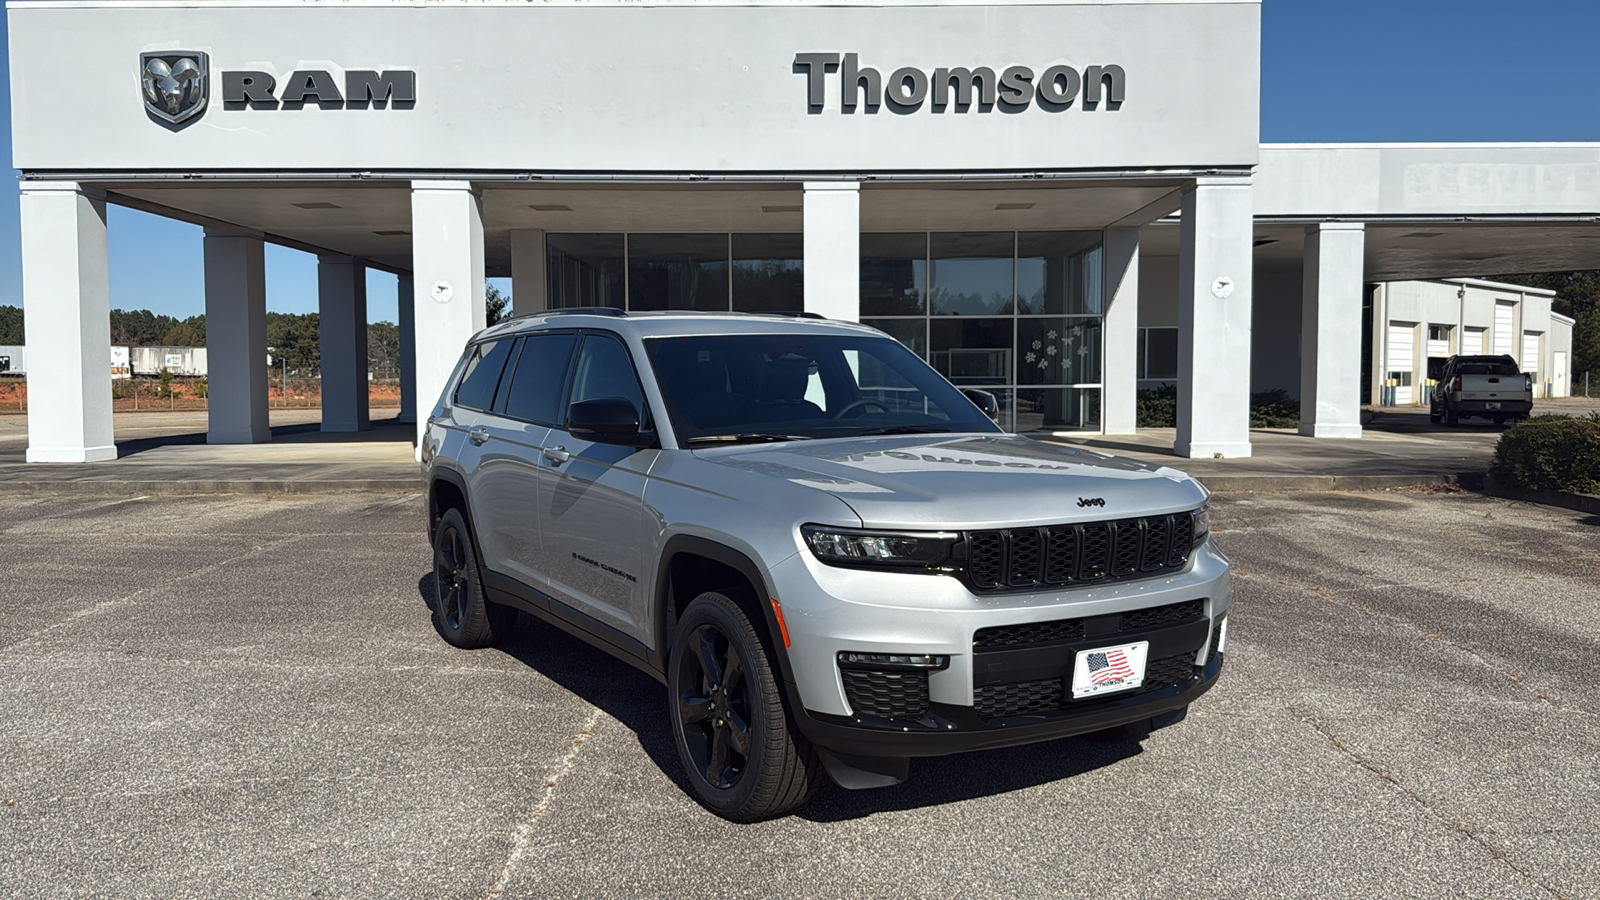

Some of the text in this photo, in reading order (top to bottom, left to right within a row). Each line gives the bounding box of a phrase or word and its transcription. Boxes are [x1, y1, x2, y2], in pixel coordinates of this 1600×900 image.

[221, 70, 416, 111] RAM
[793, 53, 1126, 115] Thomson
[1076, 496, 1106, 508] Jeep
[1099, 679, 1124, 687] THOMSON
